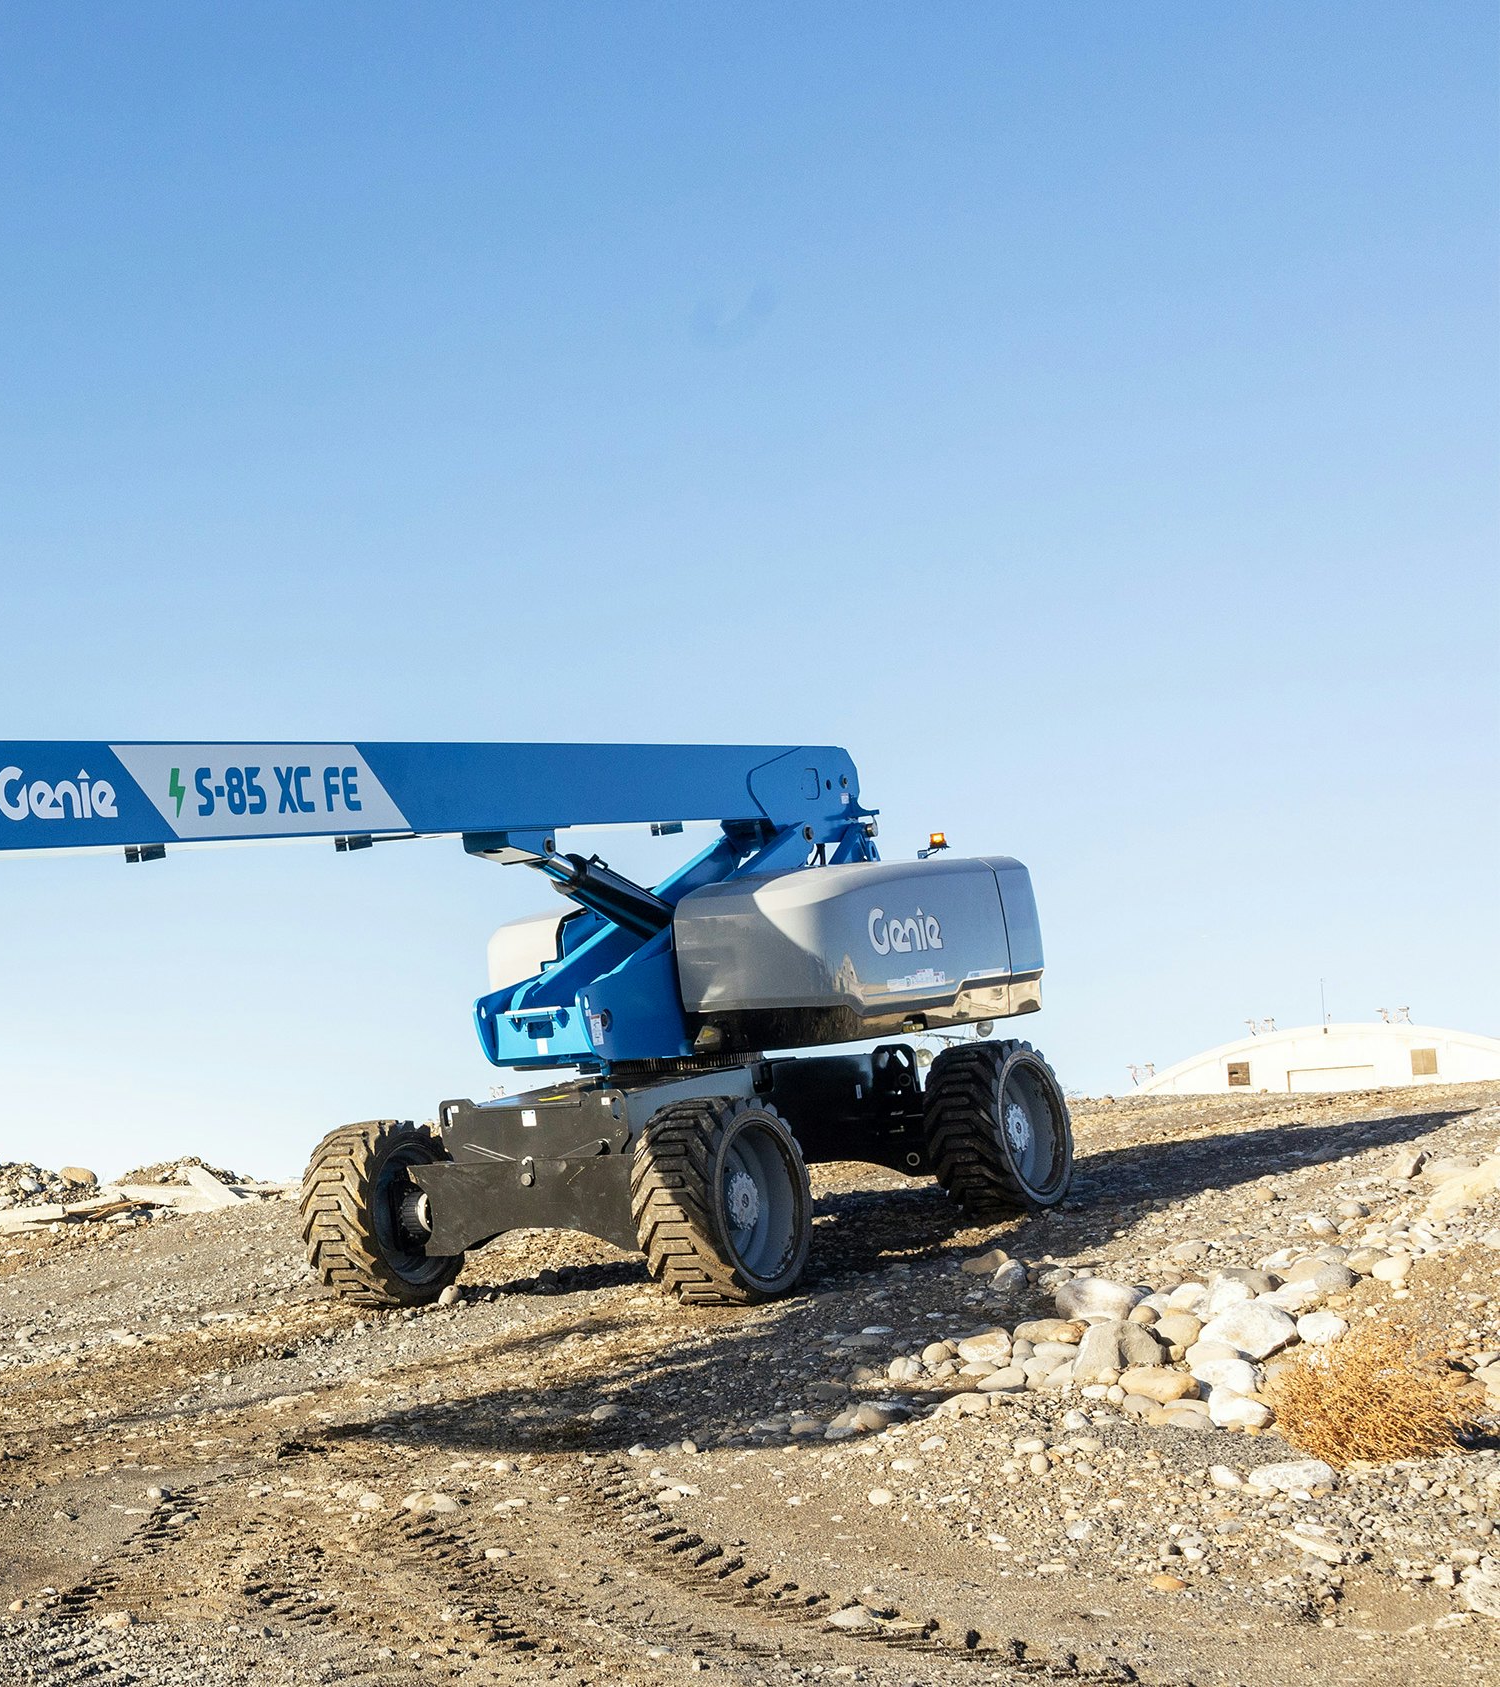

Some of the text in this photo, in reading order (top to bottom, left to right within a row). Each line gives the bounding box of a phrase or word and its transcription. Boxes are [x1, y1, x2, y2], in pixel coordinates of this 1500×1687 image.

[194, 767, 362, 816] S-85 XC FE
[867, 906, 943, 956] Genie
